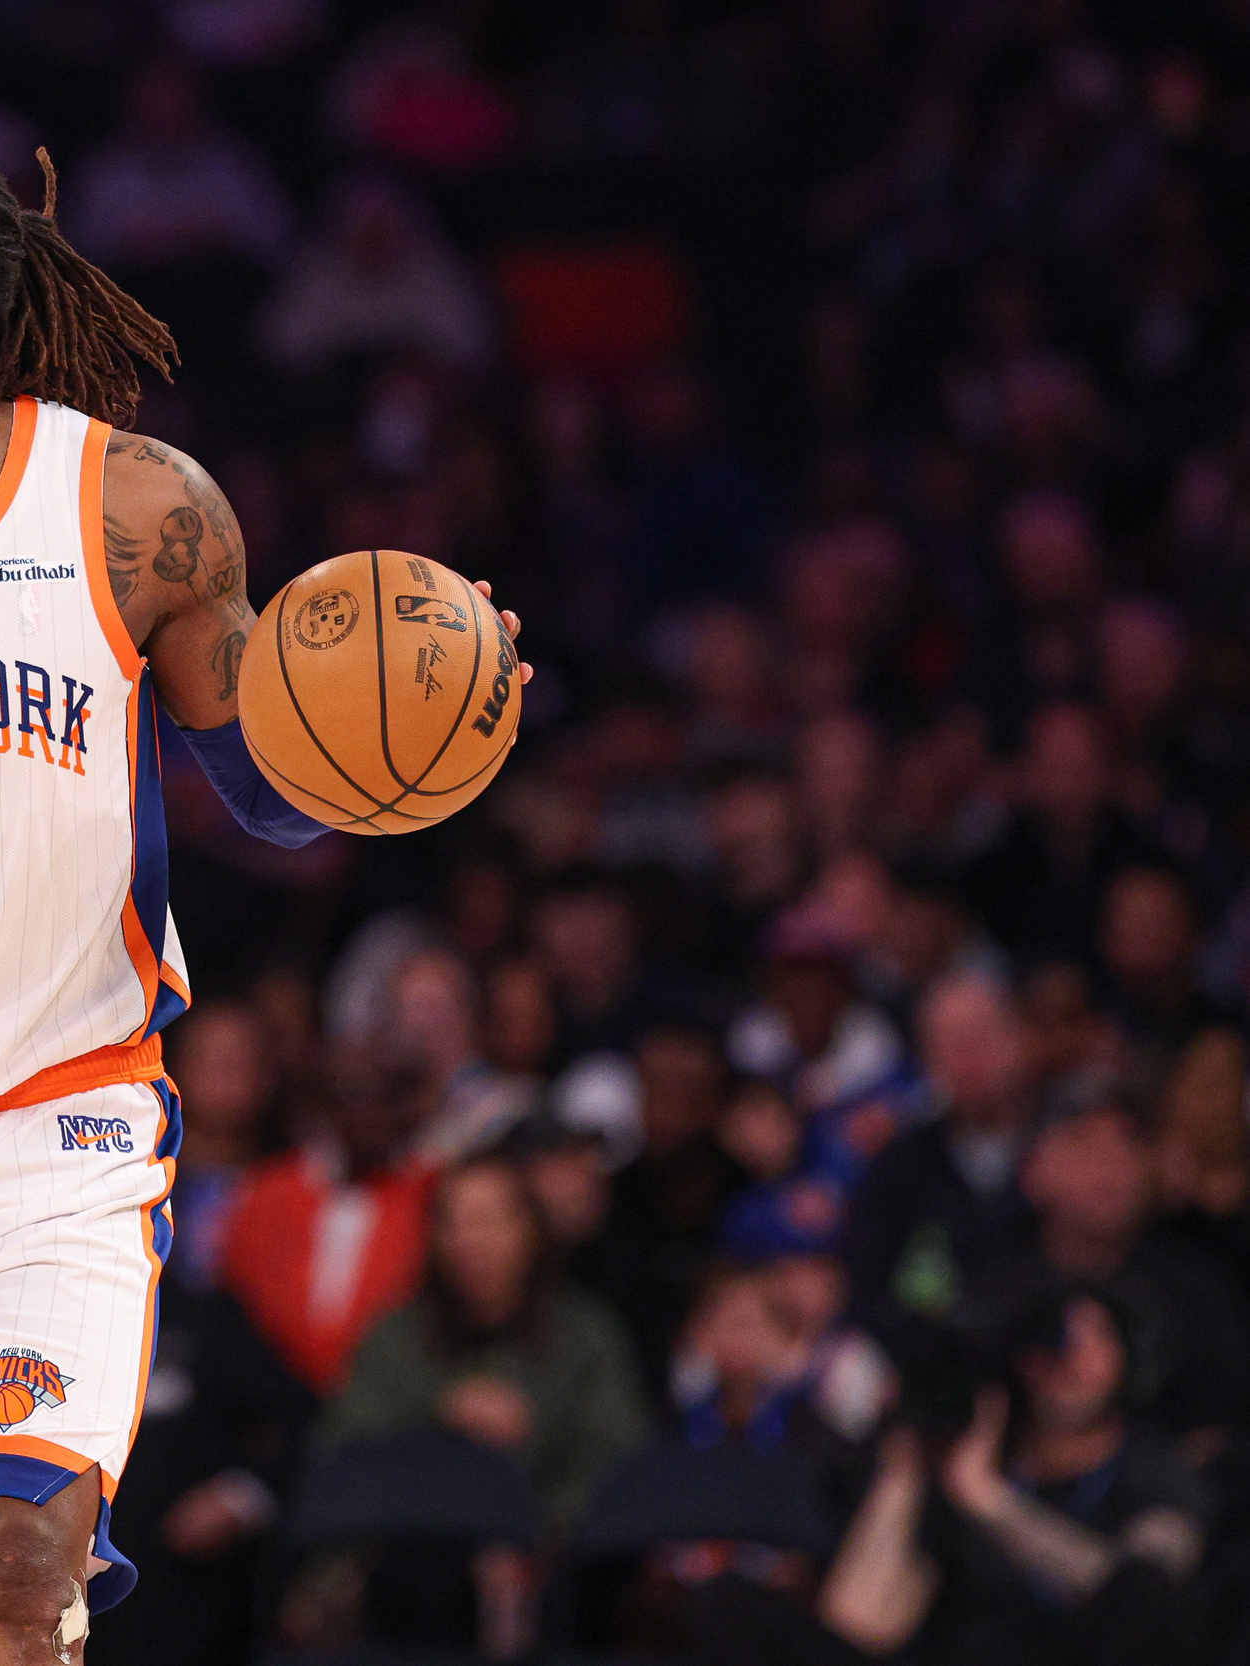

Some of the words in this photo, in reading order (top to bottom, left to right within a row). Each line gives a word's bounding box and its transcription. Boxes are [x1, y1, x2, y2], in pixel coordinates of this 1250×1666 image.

[24, 564, 75, 580] dhabi
[57, 1115, 134, 1153] NYC
[21, 1347, 42, 1362] YORK
